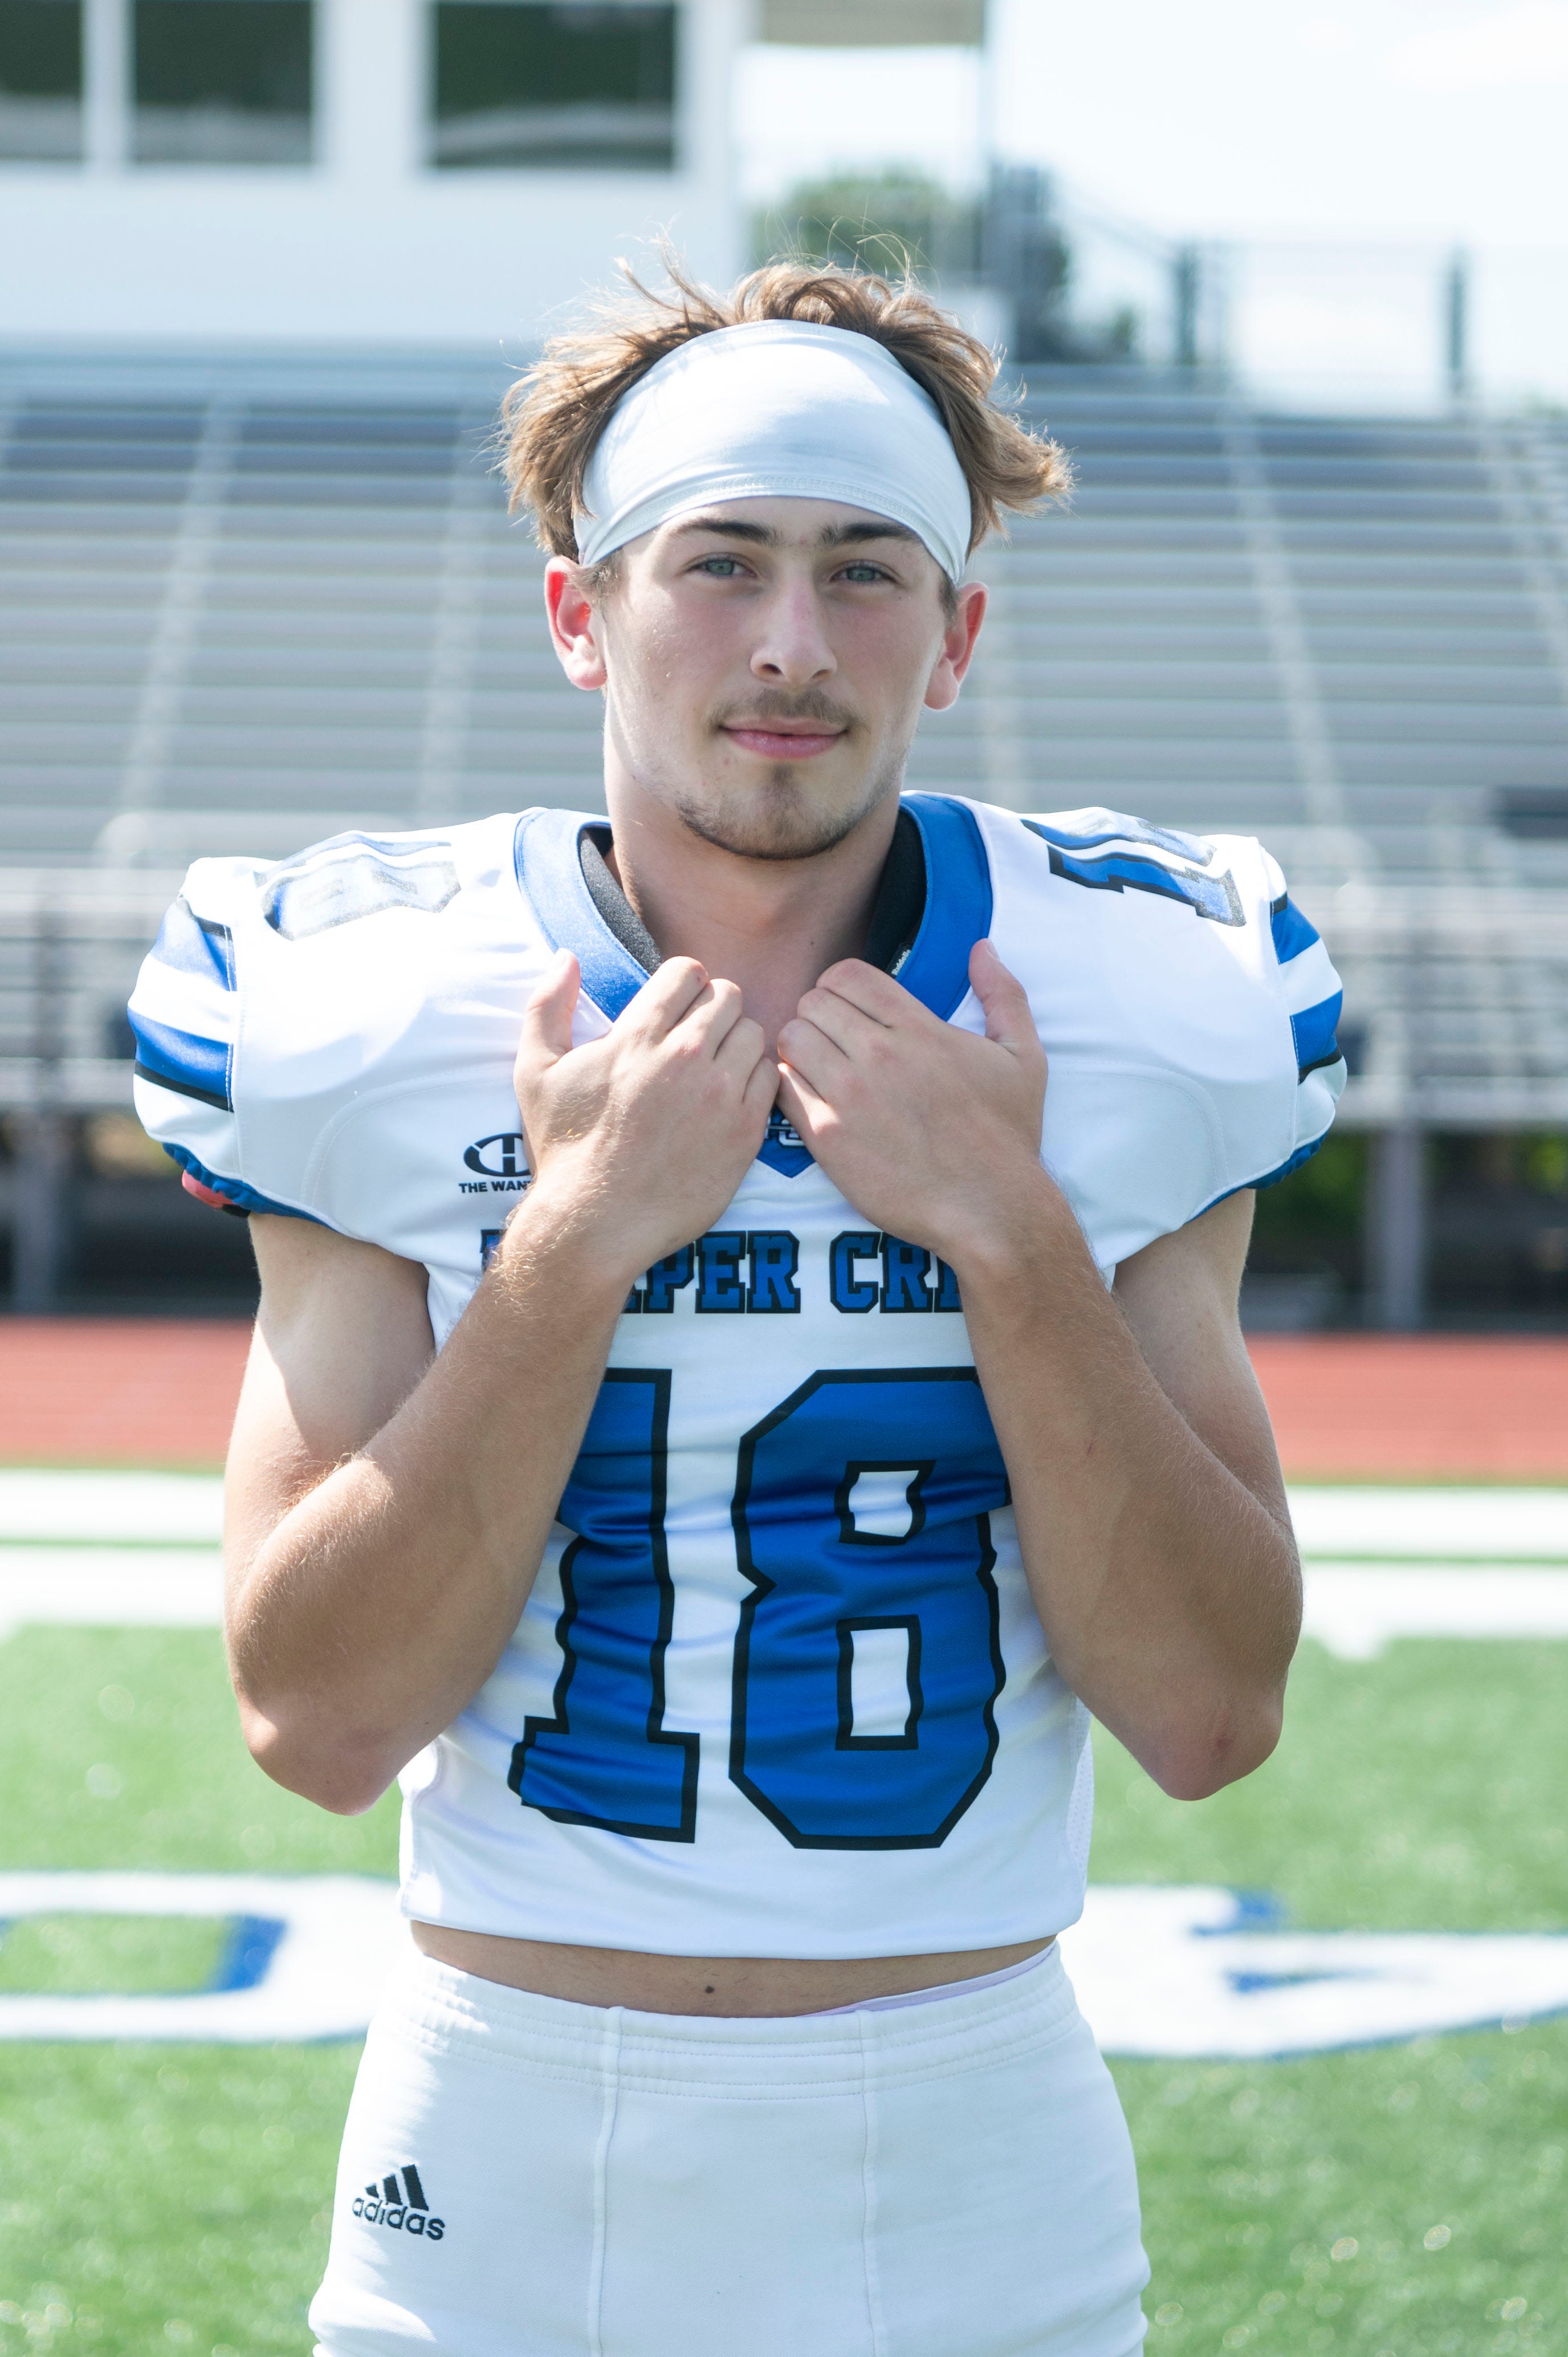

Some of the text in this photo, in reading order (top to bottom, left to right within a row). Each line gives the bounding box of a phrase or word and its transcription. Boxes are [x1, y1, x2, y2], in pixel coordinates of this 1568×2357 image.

[458, 1180, 533, 1194] THE WAN
[508, 1366, 1012, 1849] 18
[352, 2197, 445, 2241] adidas
